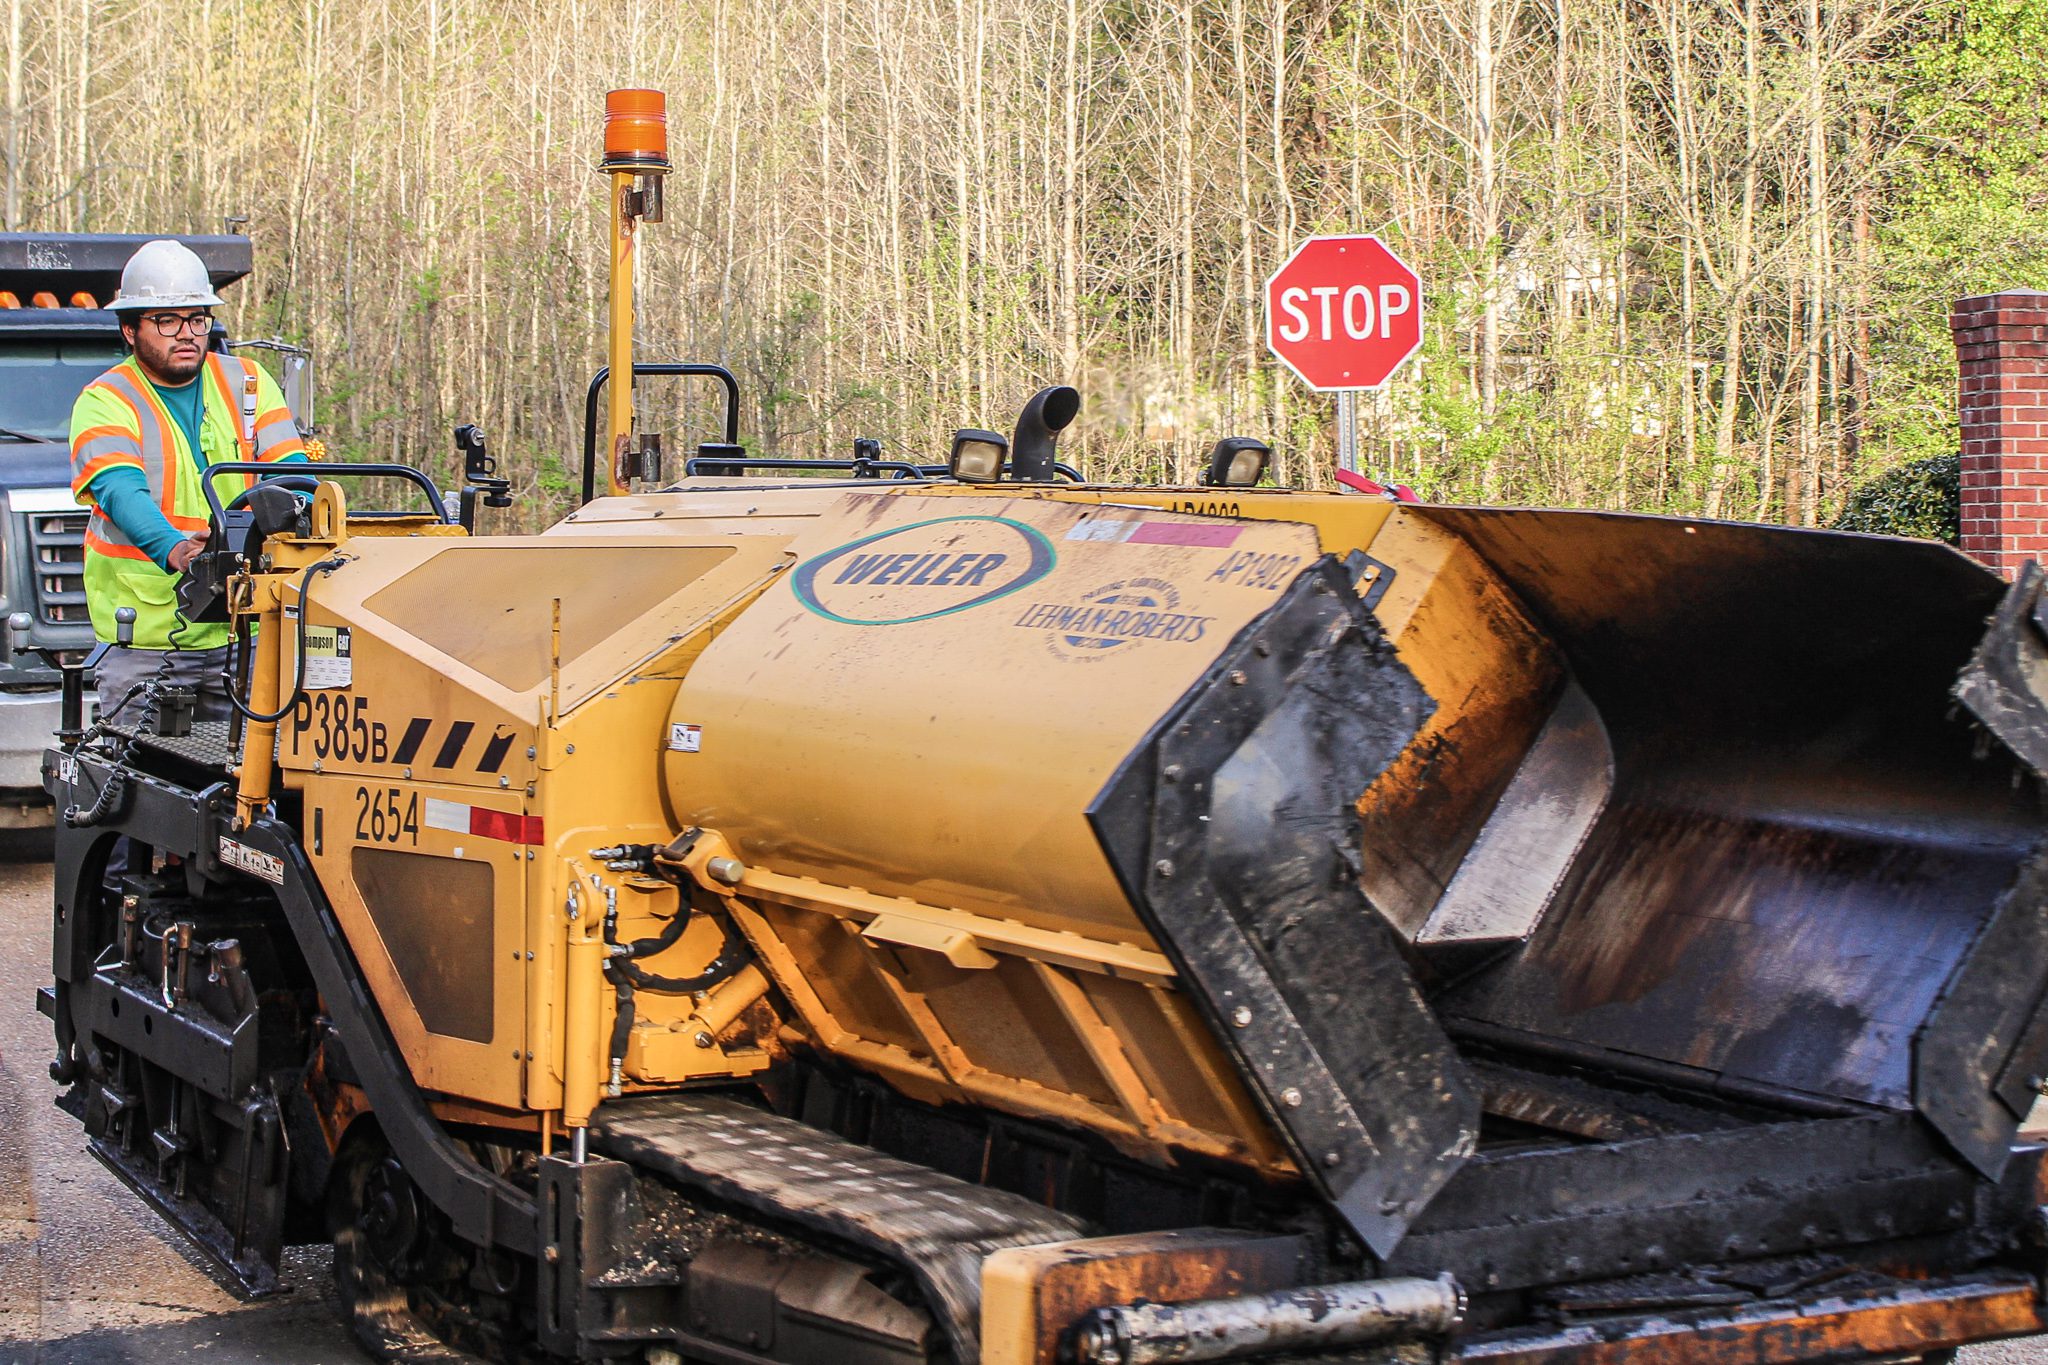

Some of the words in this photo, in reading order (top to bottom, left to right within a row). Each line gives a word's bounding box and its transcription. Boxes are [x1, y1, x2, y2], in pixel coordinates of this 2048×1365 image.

[1279, 284, 1411, 343] STOP
[832, 553, 1007, 586] WEILER
[1205, 550, 1301, 591] AP1902
[292, 691, 388, 764] P385B
[355, 786, 419, 847] 2654
